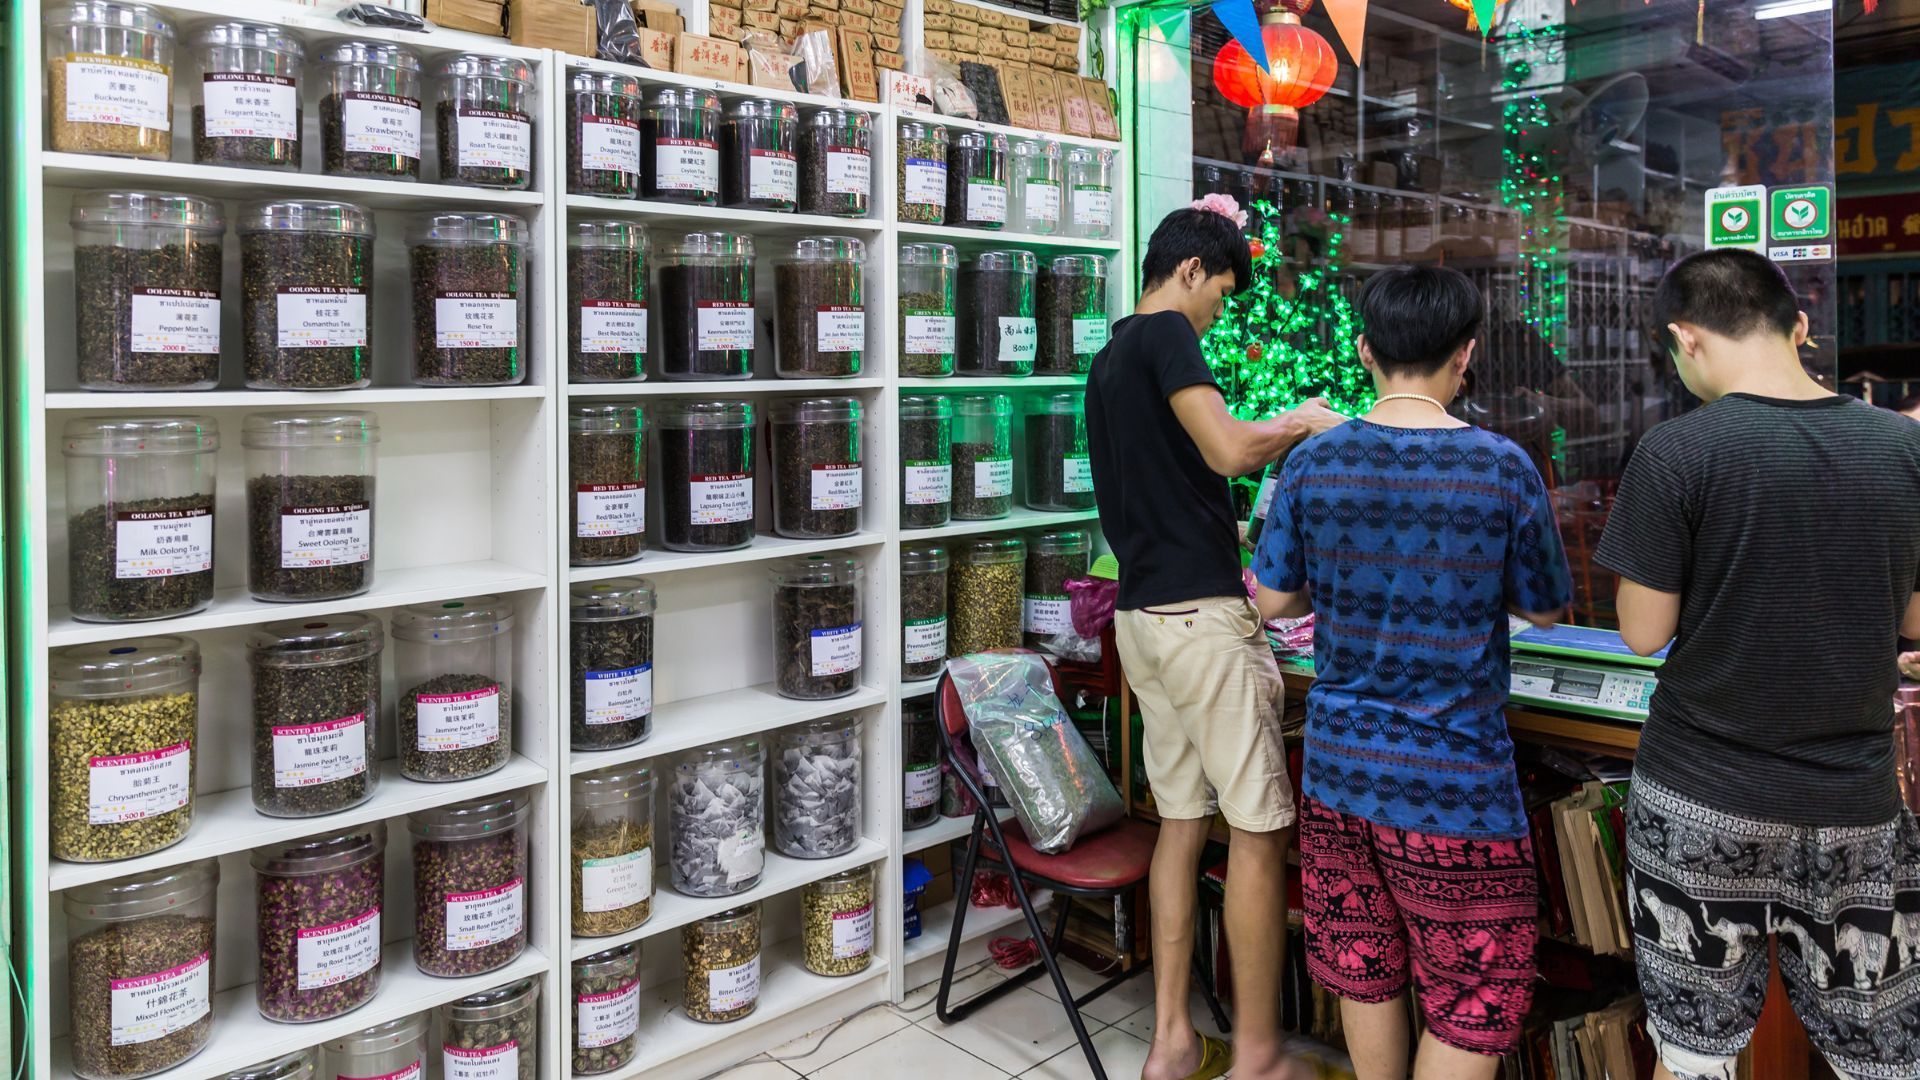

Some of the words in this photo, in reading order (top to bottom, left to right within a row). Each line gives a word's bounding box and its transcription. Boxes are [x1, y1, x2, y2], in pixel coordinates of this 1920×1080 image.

[124, 59, 141, 68] TEA
[94, 93, 136, 103] Buckwheat
[138, 98, 149, 106] tea
[357, 92, 386, 100] OOLONG
[388, 95, 401, 103] TEA
[224, 109, 254, 118] Fragrant
[255, 110, 269, 118] Rice
[270, 111, 281, 119] Tea
[498, 112, 510, 120] TEA
[599, 117, 613, 125] RED
[613, 118, 625, 127] TEA
[365, 125, 404, 137] Strawberry
[404, 130, 414, 139] Tea
[370, 145, 387, 153] 2000
[600, 146, 620, 155] Dragon
[681, 166, 697, 175] Ceylon
[1773, 250, 1789, 258] VISA
[147, 288, 181, 296] OOLONG
[289, 286, 321, 294] OOLONG
[322, 286, 337, 294] TEA
[597, 300, 611, 308] RED
[612, 301, 624, 309] TEA
[465, 312, 495, 320] 玫瑰花茶
[302, 320, 340, 328] Osmanthus
[341, 320, 351, 328] Tea
[159, 325, 184, 334] Pepper
[169, 511, 183, 519] TEA
[298, 540, 321, 548] Sweet
[322, 538, 349, 548] Oolong
[140, 548, 158, 556] Milk
[160, 546, 188, 555] Oolong
[147, 568, 166, 576] 2000
[597, 672, 620, 680] WHITE
[621, 670, 633, 678] TEA
[453, 695, 467, 703] TEA
[631, 696, 641, 704] Tea
[276, 728, 311, 736] SCENTED
[312, 725, 329, 733] TEA
[435, 726, 458, 735] Jasmine
[459, 724, 475, 732] Pearl
[475, 722, 485, 730] Tea
[95, 757, 138, 768] SCENTED
[139, 754, 156, 764] TEA
[294, 761, 320, 770] Jasmine
[321, 757, 338, 766] Pearl
[338, 754, 350, 762] Tea
[169, 783, 179, 792] Tea
[451, 892, 484, 902] SCENTED
[485, 890, 498, 900] TEA
[459, 925, 476, 933] Small
[476, 922, 490, 931] Rose
[490, 916, 508, 927] Flower
[508, 913, 517, 921] Tea
[302, 926, 339, 939] SCENTED
[340, 922, 354, 933] TEA
[316, 960, 328, 969] Big
[329, 957, 344, 966] Rose
[345, 951, 363, 961] Flower
[364, 945, 372, 953] Tea
[117, 976, 159, 990] SCENTED
[160, 971, 177, 983] TEA
[146, 986, 189, 1009] 什錦花茶
[135, 1010, 159, 1022] Mixed
[160, 1002, 186, 1016] Flowers
[186, 997, 196, 1007] tea
[596, 1021, 612, 1031] Globe
[469, 1050, 483, 1058] TEA
